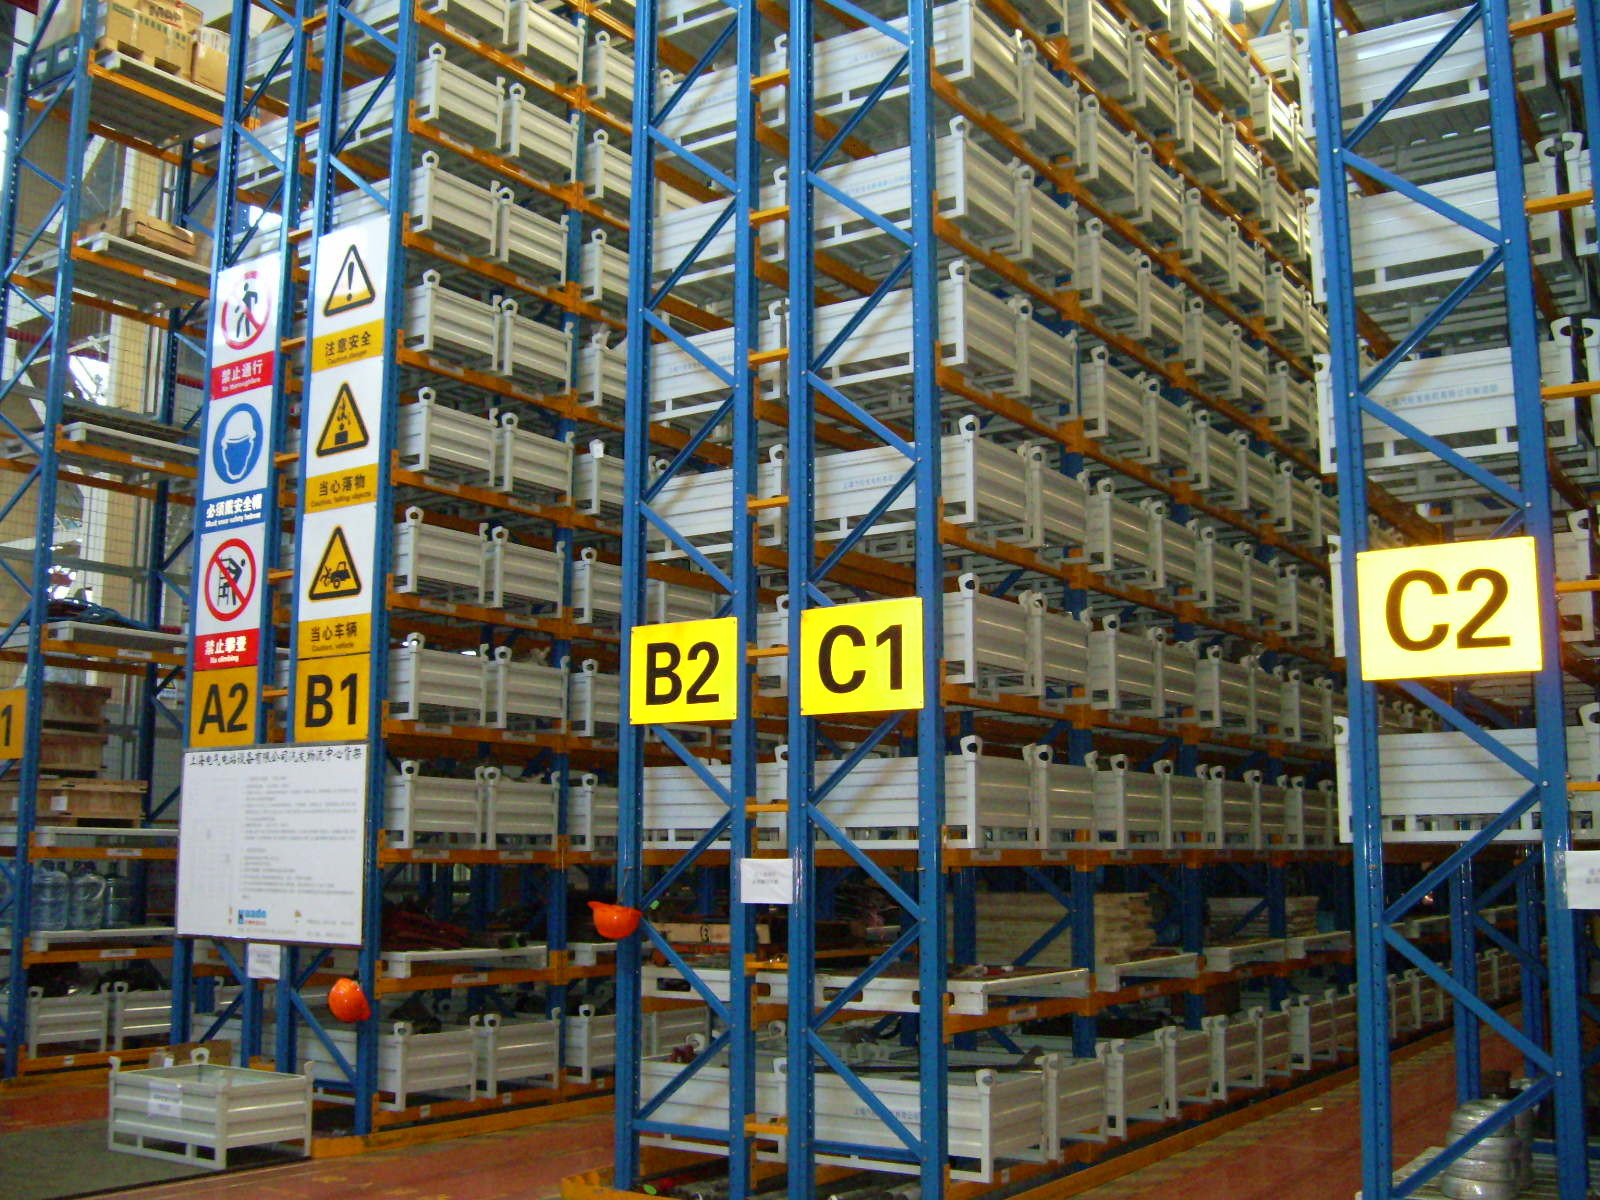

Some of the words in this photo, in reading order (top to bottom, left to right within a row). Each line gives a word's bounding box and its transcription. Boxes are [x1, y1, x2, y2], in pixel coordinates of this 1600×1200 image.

[325, 331, 371, 356] 注意安全
[221, 359, 263, 384] 禁止通行
[319, 474, 366, 496] 当心落物
[206, 493, 263, 519] 必须戴安全帽
[1386, 568, 1511, 652] C2
[311, 621, 358, 642] 当心车辆
[204, 635, 247, 656] 禁止攀登
[818, 624, 903, 694] C1
[645, 641, 720, 706] B2
[198, 683, 248, 734] A2
[305, 673, 357, 728] B1
